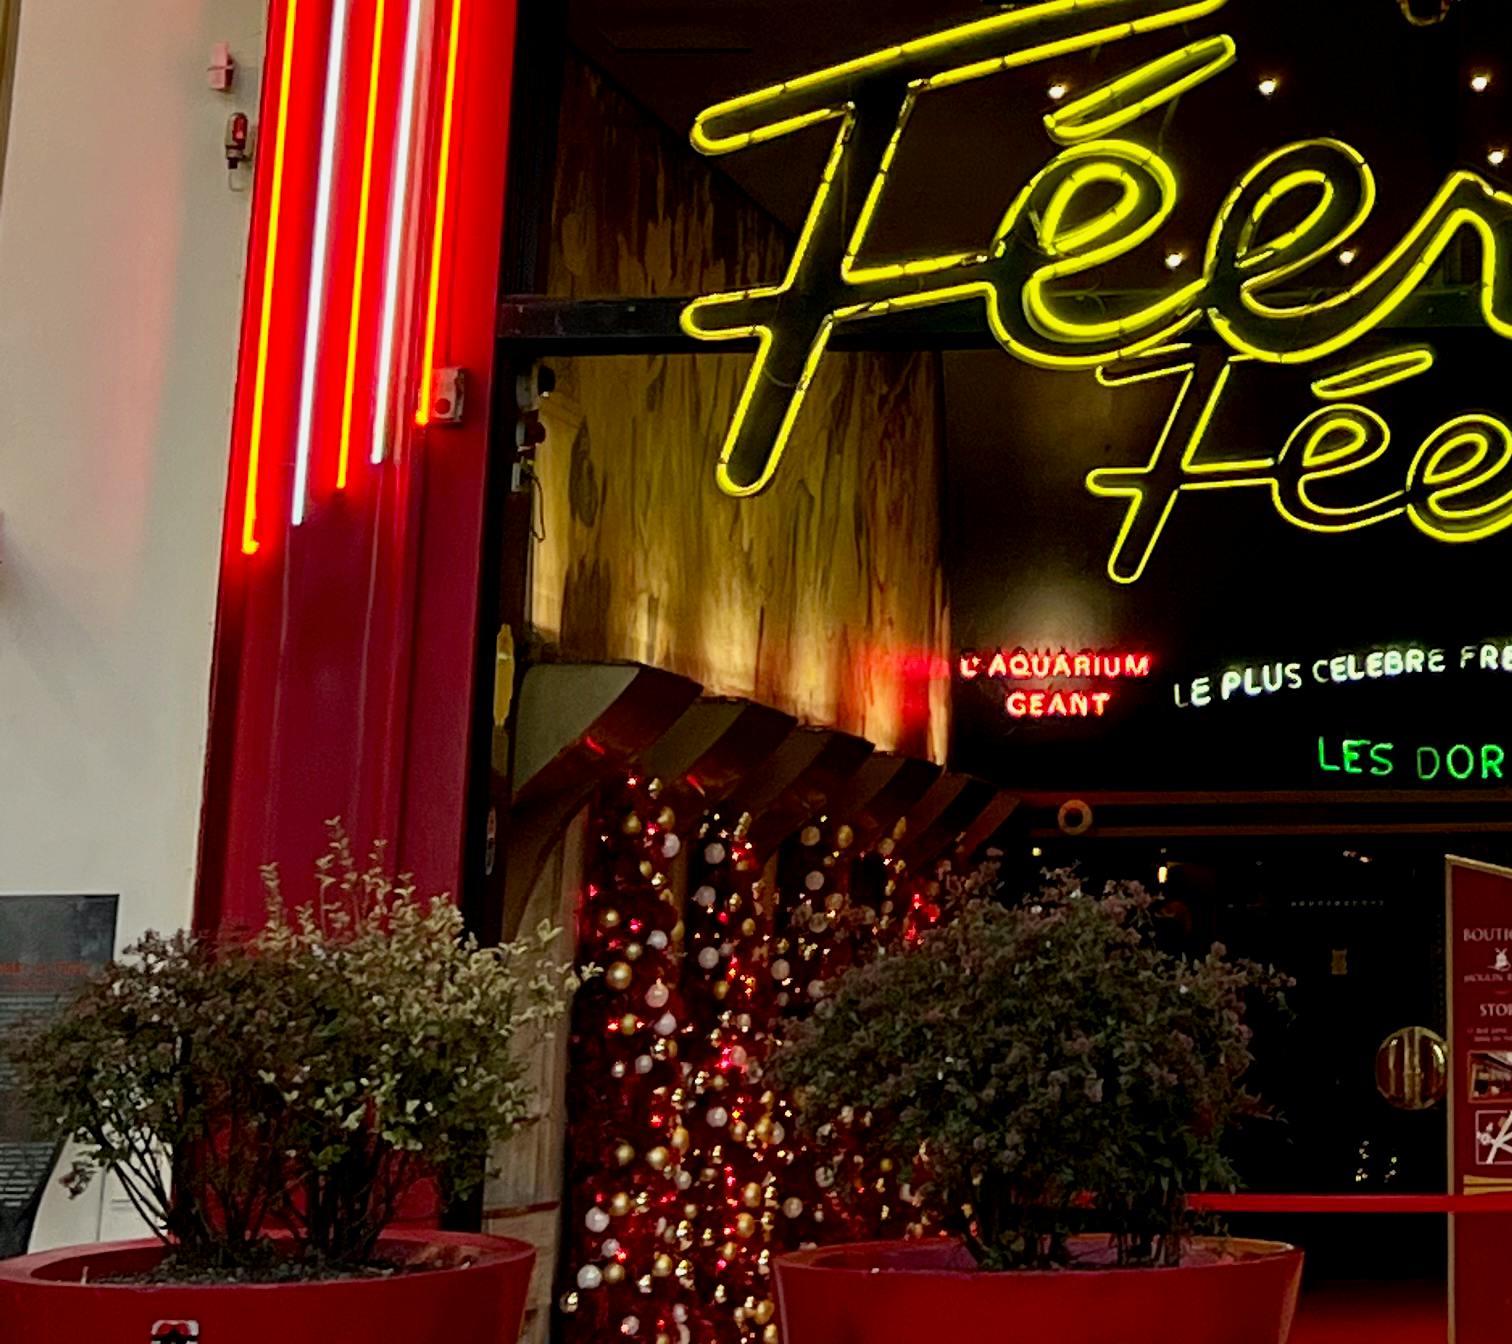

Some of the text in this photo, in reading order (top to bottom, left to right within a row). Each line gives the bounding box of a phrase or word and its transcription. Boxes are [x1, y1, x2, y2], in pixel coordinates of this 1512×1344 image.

[1172, 676, 1213, 708] LE
[1220, 662, 1304, 701] PLUS
[1311, 647, 1447, 684] CELEBRE
[1005, 689, 1112, 718] GEANT
[1318, 736, 1395, 775] LES
